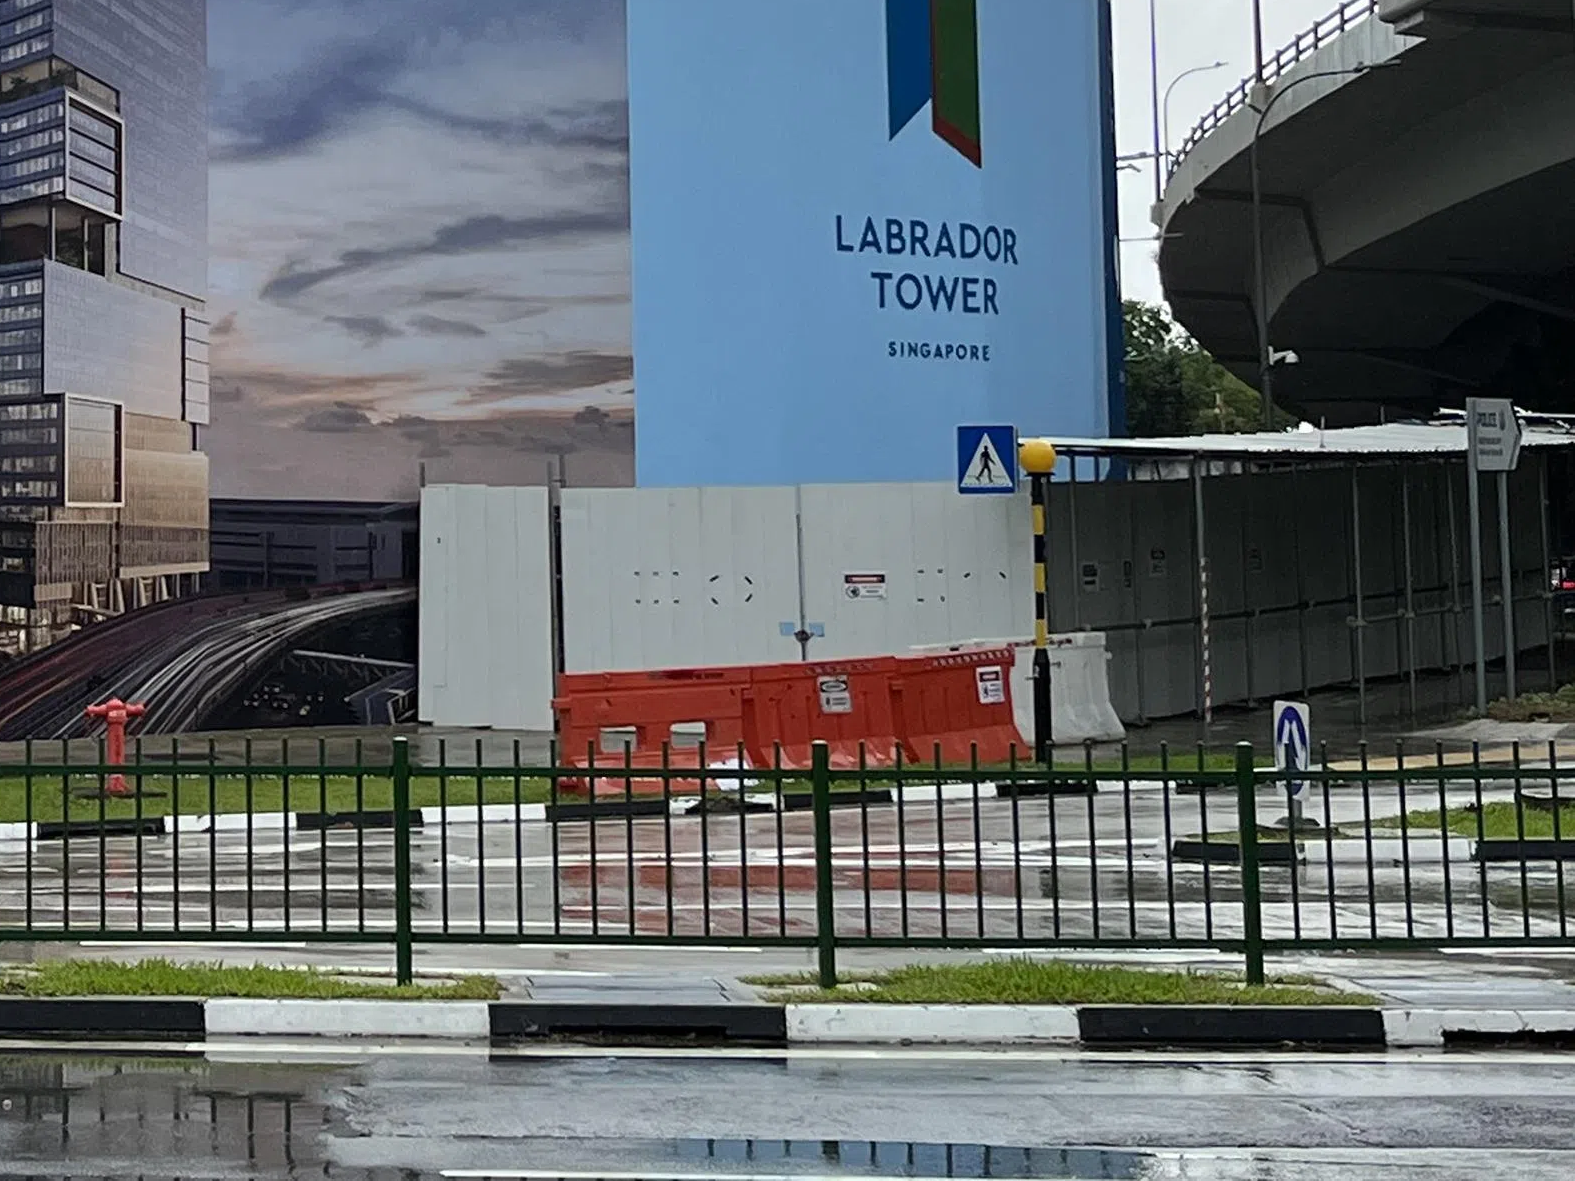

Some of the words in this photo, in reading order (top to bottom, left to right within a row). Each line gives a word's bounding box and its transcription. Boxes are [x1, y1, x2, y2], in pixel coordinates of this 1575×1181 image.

[836, 215, 1018, 265] LABRADOR
[871, 272, 999, 315] TOWER
[888, 341, 990, 361] SINGAPORE
